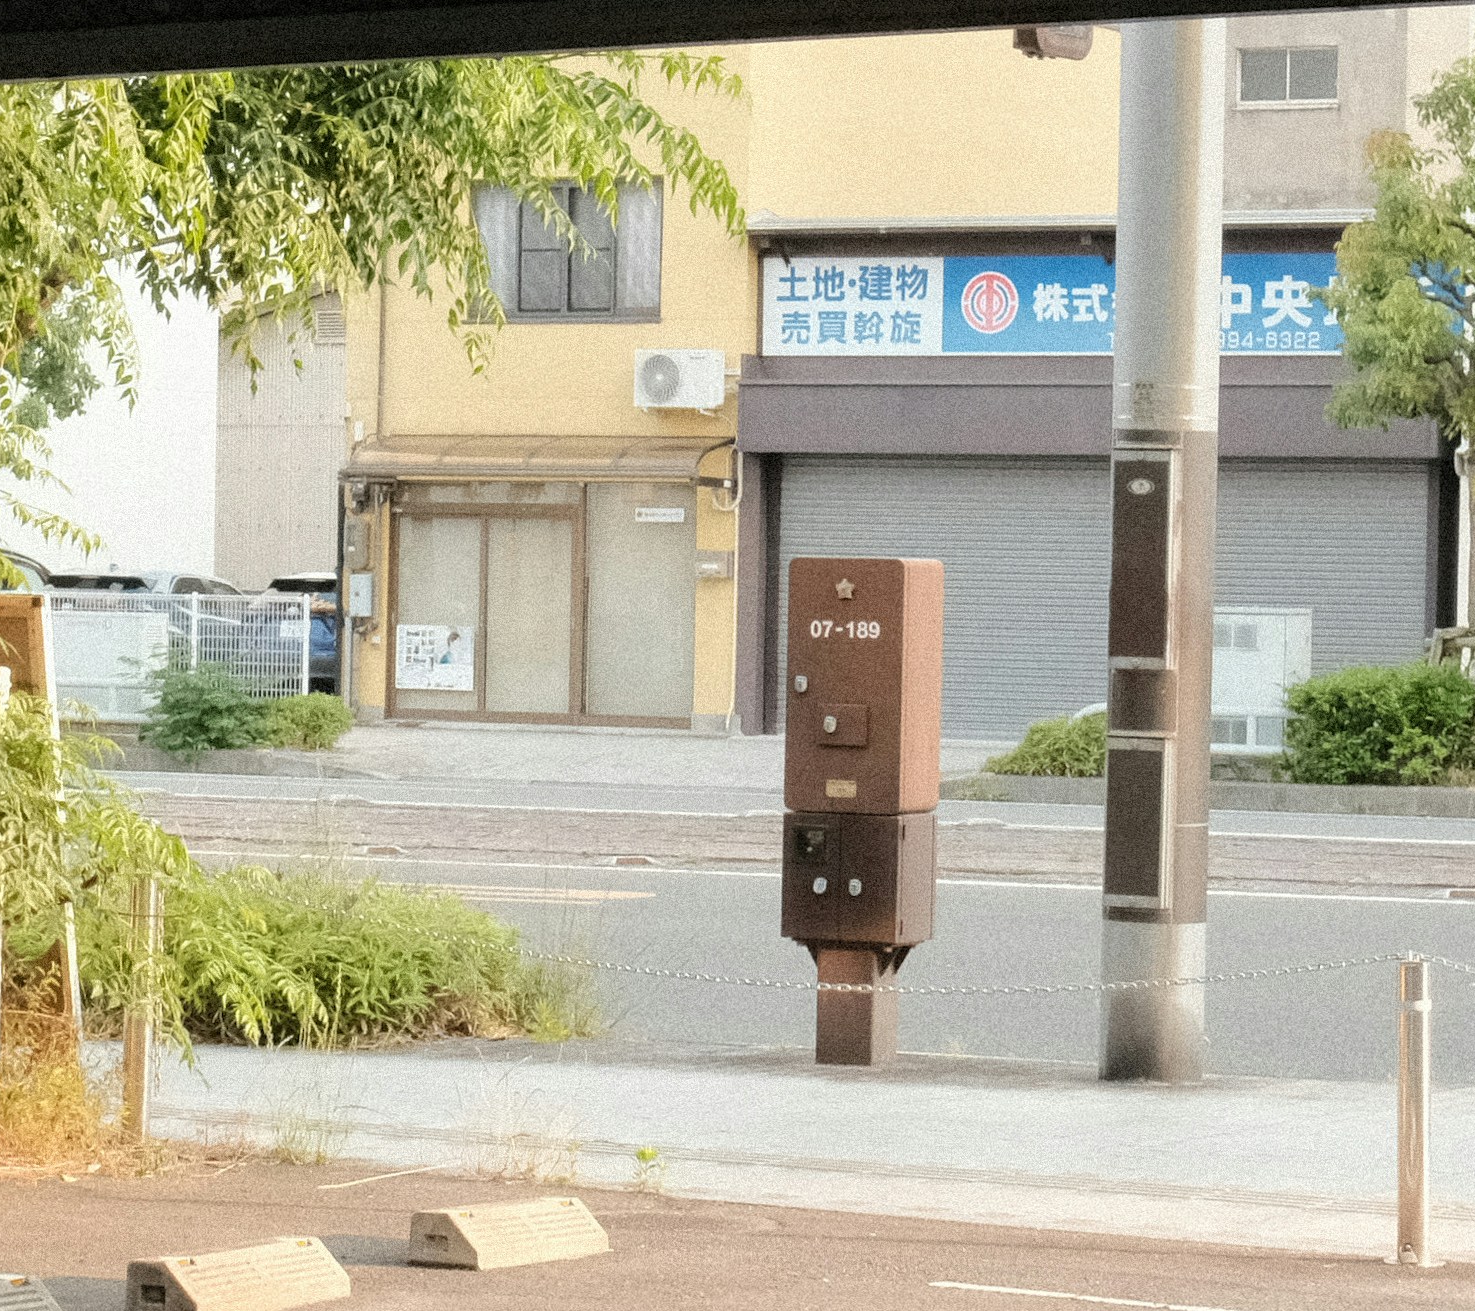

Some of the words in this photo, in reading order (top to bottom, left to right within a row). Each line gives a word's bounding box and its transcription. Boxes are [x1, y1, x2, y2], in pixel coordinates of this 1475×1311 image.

[776, 264, 929, 302] 土地・建物
[1032, 282, 1115, 323] 株式
[809, 619, 881, 639] 07-189
